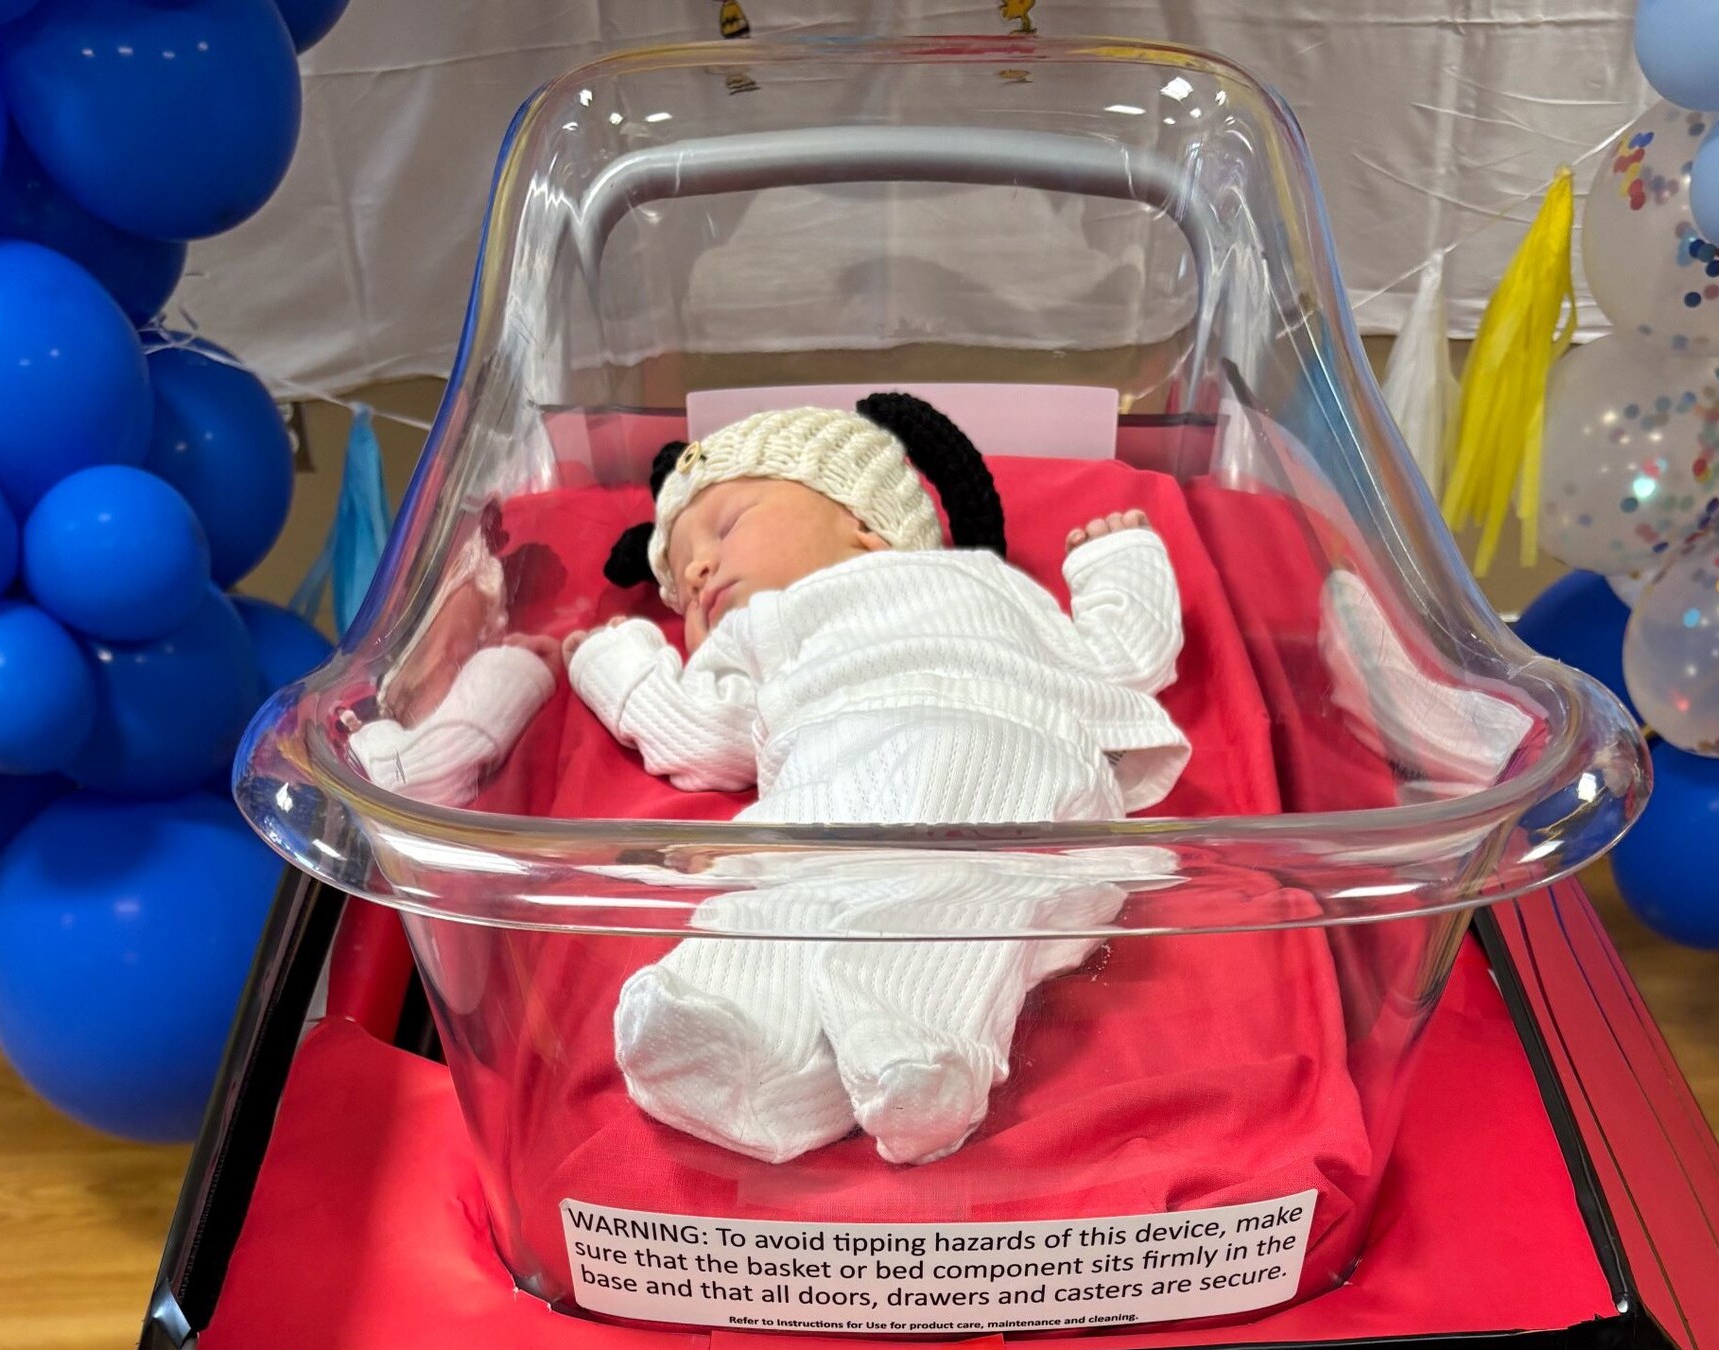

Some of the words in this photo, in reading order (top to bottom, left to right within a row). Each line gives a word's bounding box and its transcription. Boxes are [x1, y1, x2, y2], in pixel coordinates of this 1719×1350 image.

[567, 1207, 708, 1245] WARNING:
[714, 1227, 746, 1248] To
[754, 1231, 825, 1251] avoid
[832, 1232, 927, 1257] tipping
[935, 1230, 1036, 1252] hazards
[1044, 1227, 1074, 1249] of
[1078, 1226, 1127, 1247] this
[1135, 1219, 1226, 1243] device,
[1236, 1205, 1303, 1233] make
[574, 1241, 627, 1265] sure
[634, 1247, 689, 1271] that
[694, 1253, 738, 1275] the
[747, 1255, 832, 1279] basket
[839, 1265, 868, 1279] or
[876, 1259, 924, 1280] bed
[932, 1257, 1084, 1283] component
[1090, 1253, 1134, 1274] sits
[1142, 1245, 1219, 1270] firmly
[1225, 1242, 1248, 1262] in
[1256, 1235, 1296, 1257] the
[580, 1263, 638, 1293] base
[646, 1278, 693, 1298] and
[700, 1280, 754, 1302] that
[761, 1284, 790, 1304] all
[798, 1285, 878, 1310] doors,
[887, 1287, 990, 1307] drawers
[998, 1283, 1046, 1305] and
[1054, 1283, 1143, 1303] casters
[1150, 1279, 1192, 1295] are
[1199, 1265, 1287, 1291] secure.
[729, 1316, 759, 1326] Refer
[762, 1318, 774, 1327] to
[777, 1319, 844, 1329] Instructions
[847, 1320, 863, 1329] for
[866, 1321, 887, 1329] Use
[890, 1320, 907, 1329] for
[910, 1320, 954, 1330] product
[957, 1321, 984, 1330] care,
[987, 1318, 1061, 1328] maintenance
[1064, 1316, 1085, 1325] and
[1088, 1313, 1139, 1323] cleaning.
